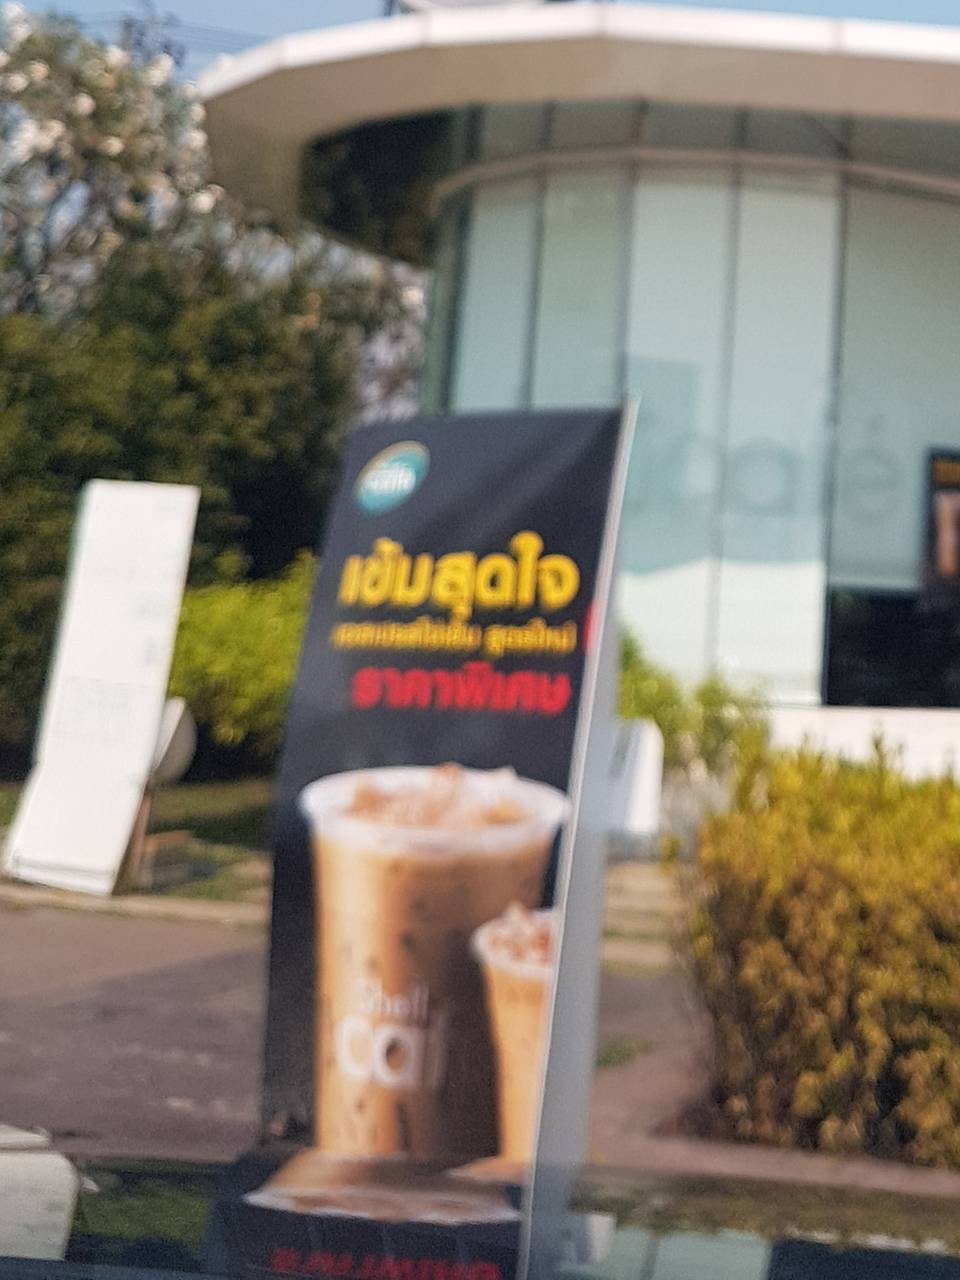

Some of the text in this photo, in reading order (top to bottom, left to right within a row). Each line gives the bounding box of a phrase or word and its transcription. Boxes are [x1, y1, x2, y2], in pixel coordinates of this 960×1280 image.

[338, 532, 580, 619] เข้มสุดใจ
[352, 661, 571, 715] ราคาพิเศษ
